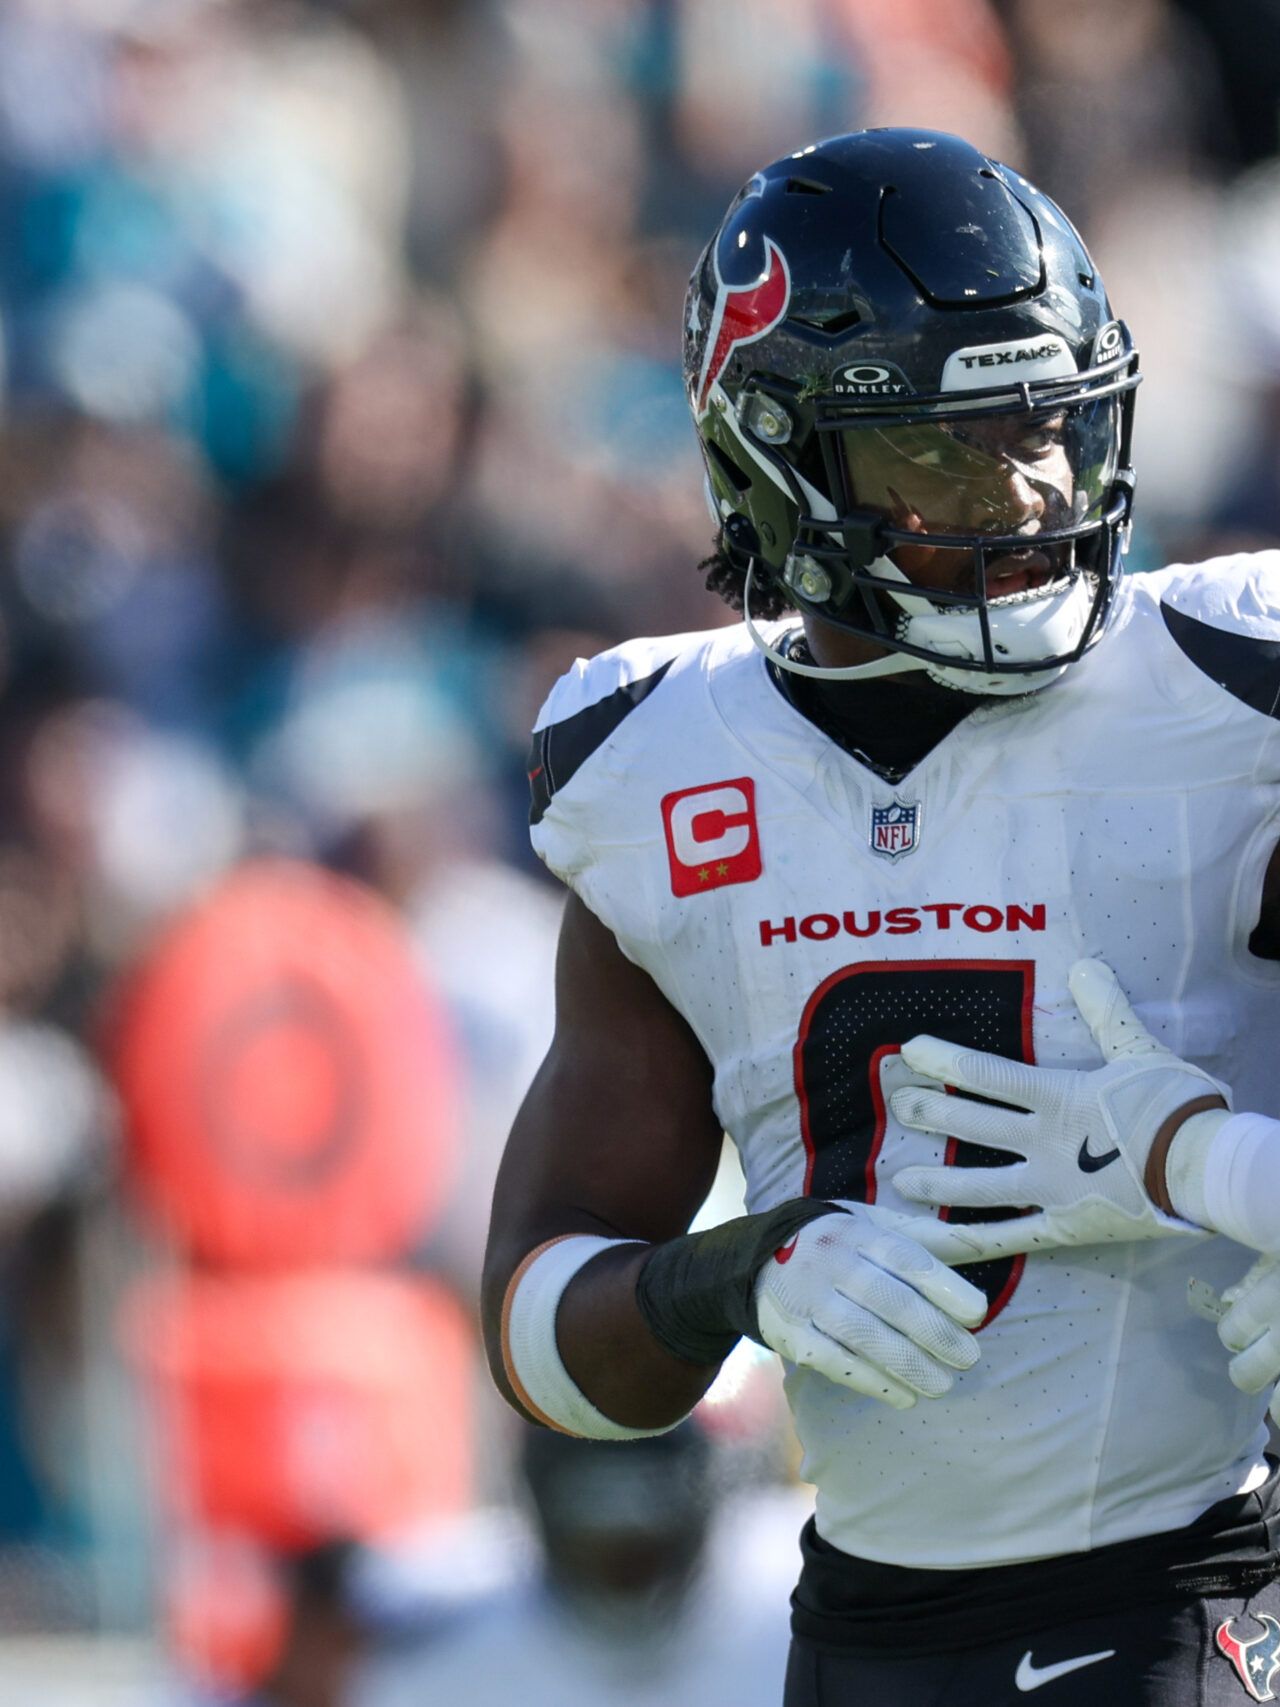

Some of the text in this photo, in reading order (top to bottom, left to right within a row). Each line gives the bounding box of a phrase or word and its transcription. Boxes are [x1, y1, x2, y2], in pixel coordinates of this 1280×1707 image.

[958, 343, 1062, 369] TEXANS
[835, 383, 902, 394] OAKLEY
[670, 786, 750, 867] C
[875, 825, 911, 850] NFL
[758, 903, 1046, 947] HOUSTON
